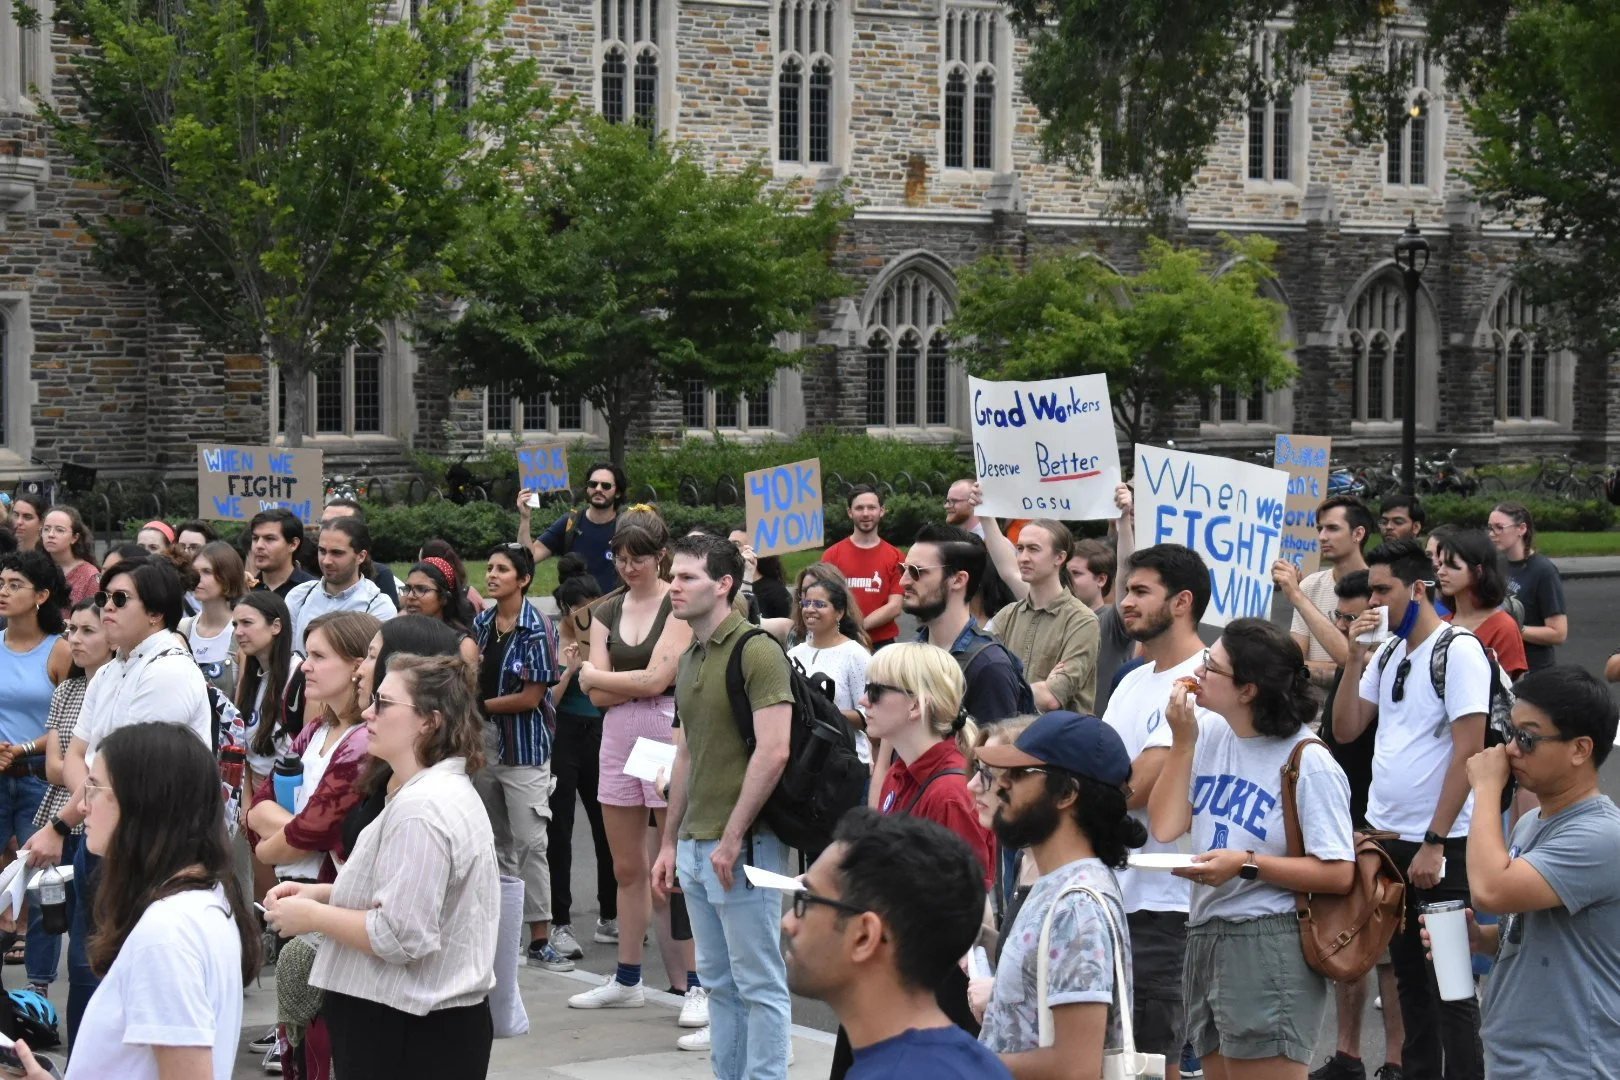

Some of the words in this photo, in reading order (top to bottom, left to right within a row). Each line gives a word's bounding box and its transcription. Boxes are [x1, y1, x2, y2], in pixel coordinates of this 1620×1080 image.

[975, 389, 1026, 427] Grad
[1028, 386, 1100, 423] Workers
[203, 448, 254, 473] WHEN
[268, 453, 296, 475] WE
[519, 447, 564, 472] 40K
[976, 443, 1020, 478] Deserve
[1035, 441, 1098, 477] Better
[228, 475, 298, 499] FIGHT
[524, 472, 569, 493] NOW
[751, 465, 817, 513] 40K
[1142, 454, 1247, 514] When
[1256, 496, 1283, 529] we
[1287, 475, 1319, 497] an't
[212, 495, 244, 518] WE
[1022, 497, 1071, 510] DGSU
[755, 508, 825, 554] NOW
[1285, 509, 1318, 528] ork
[1155, 504, 1278, 575] FIGHT
[1280, 534, 1318, 553] ithout
[1209, 568, 1272, 619] WIN
[1192, 774, 1276, 841] DUKE
